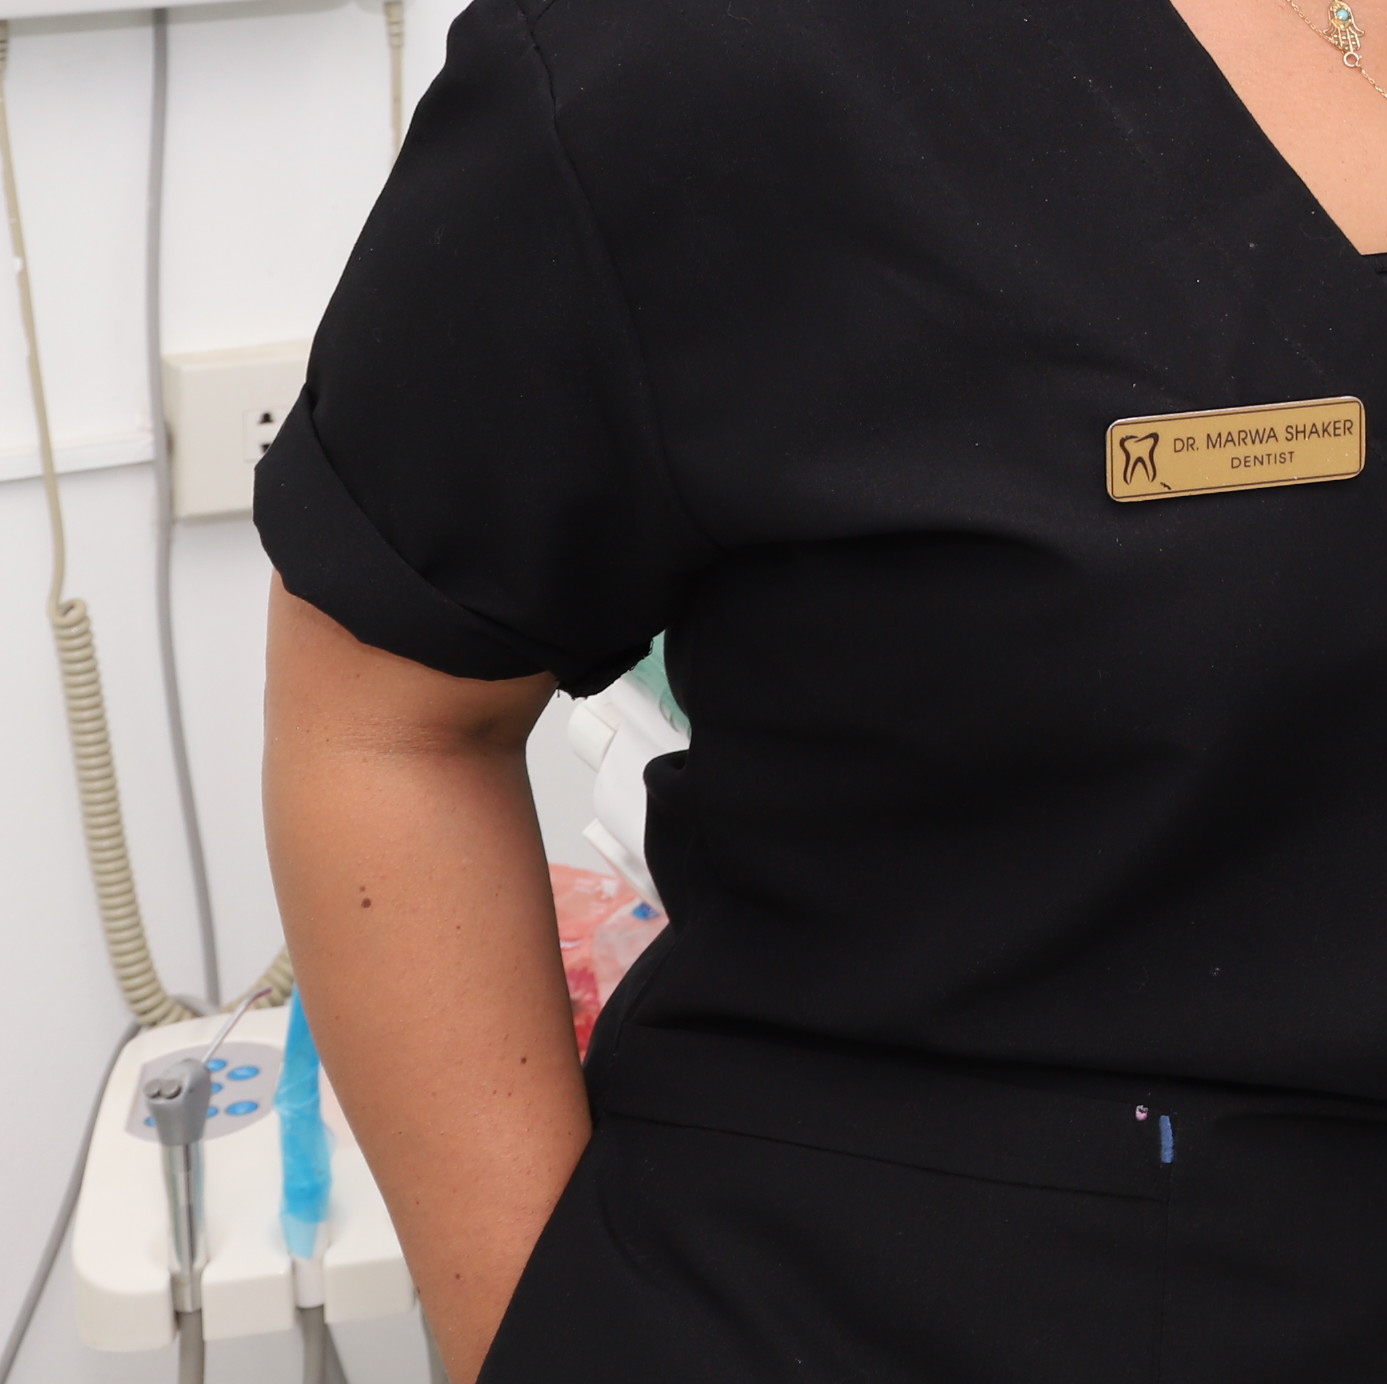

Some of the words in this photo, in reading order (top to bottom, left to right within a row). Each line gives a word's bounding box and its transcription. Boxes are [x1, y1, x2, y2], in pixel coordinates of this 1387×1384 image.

[1173, 437, 1200, 454] DR.
[1206, 428, 1279, 450] MARWA
[1285, 419, 1354, 442] SHAKER
[1231, 451, 1295, 469] DENTIST
